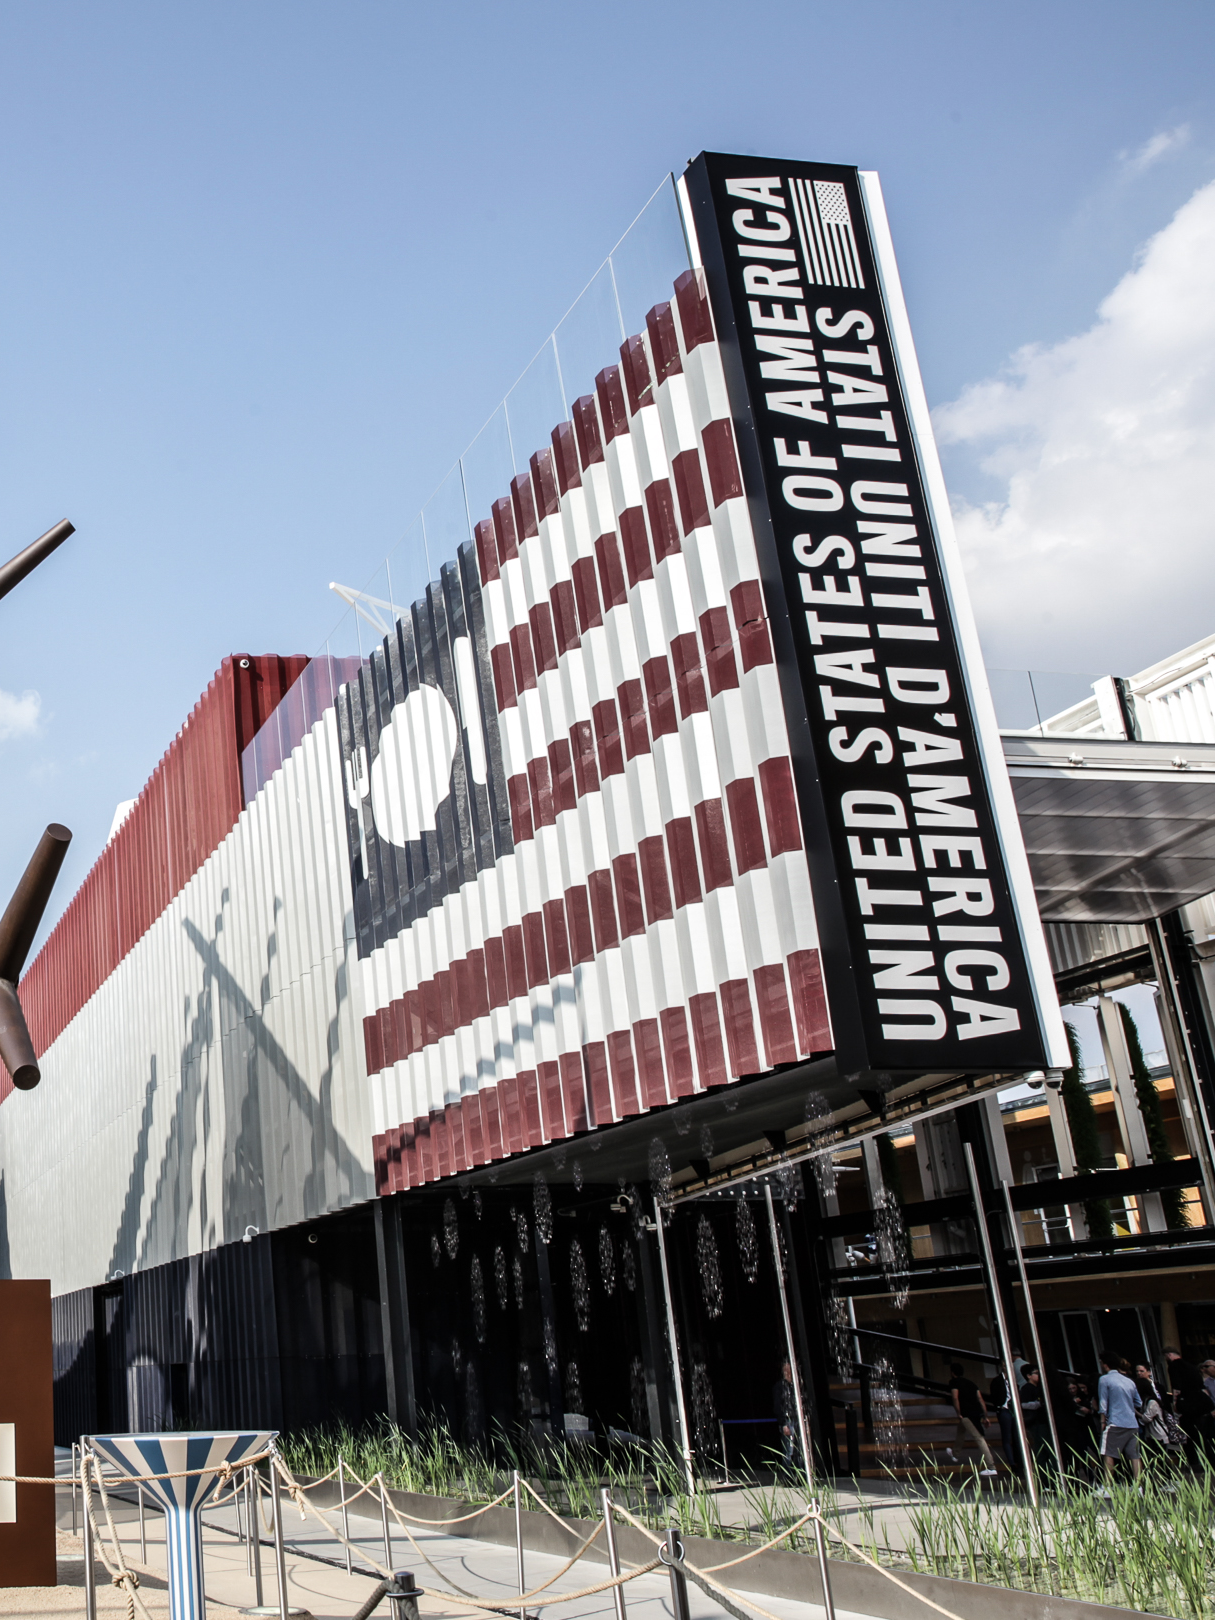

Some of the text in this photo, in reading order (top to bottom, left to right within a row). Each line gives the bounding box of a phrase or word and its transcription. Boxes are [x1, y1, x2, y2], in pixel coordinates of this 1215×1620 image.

[816, 307, 902, 462] STATI
[725, 176, 947, 1040] UNITED STATES OF AMERICA
[850, 480, 939, 641] UNITI
